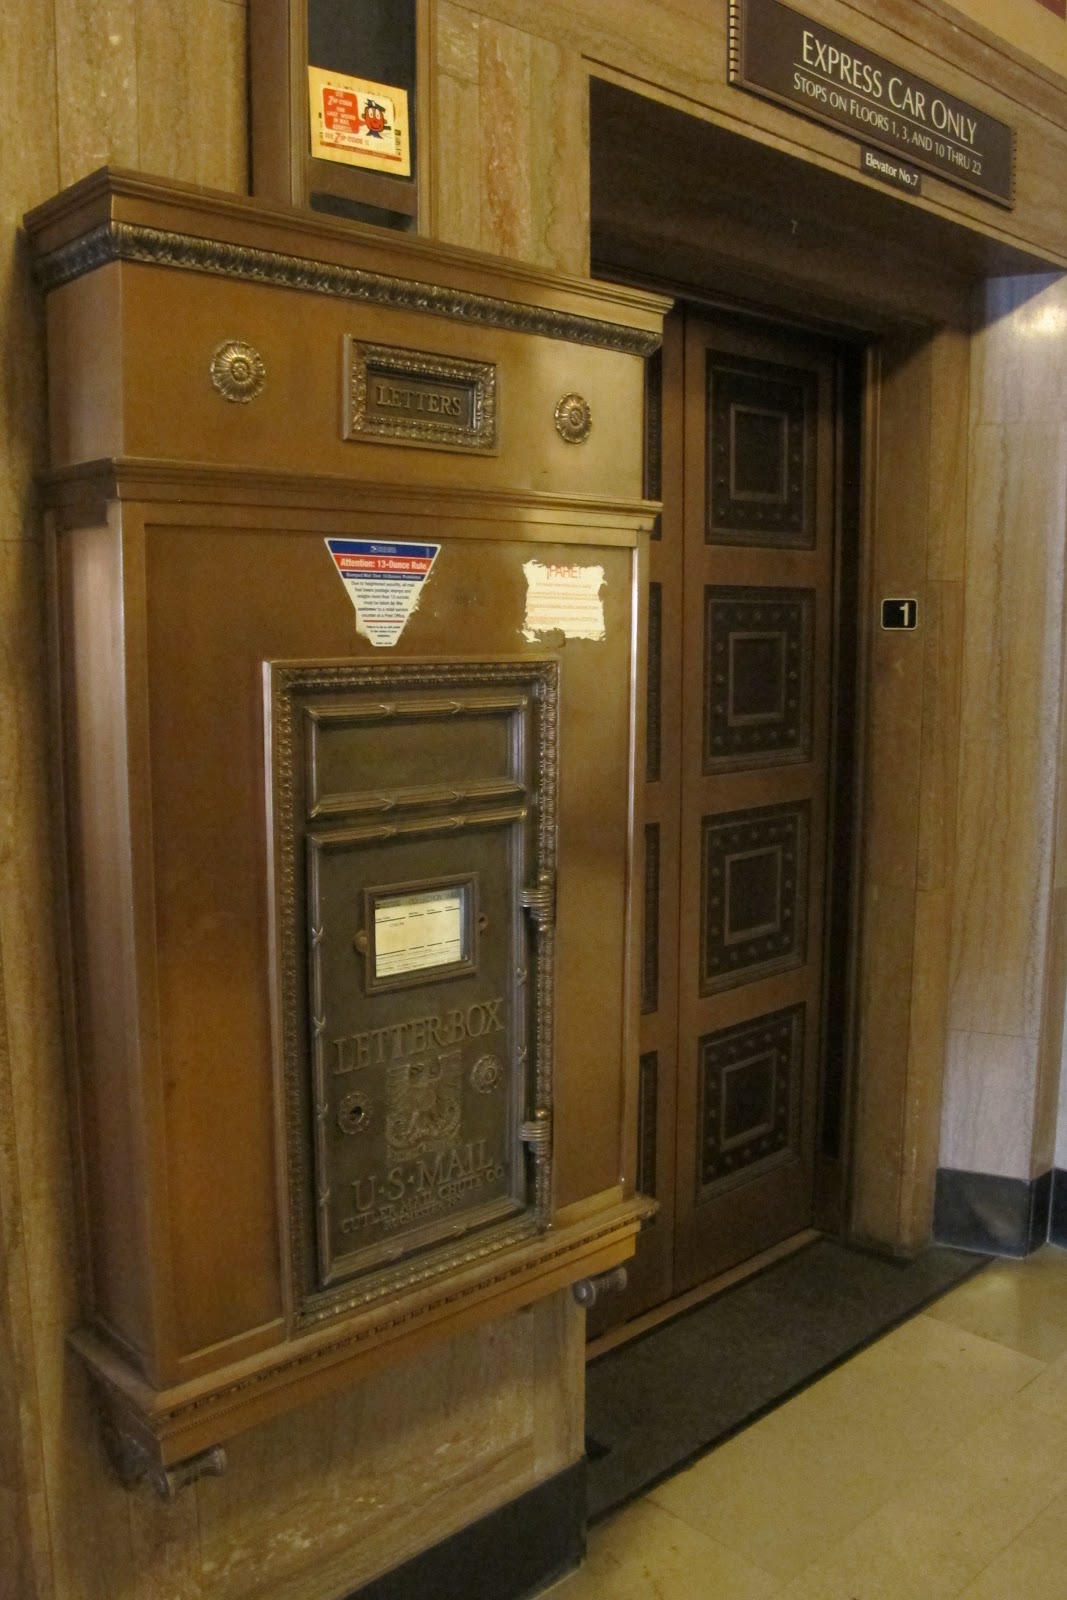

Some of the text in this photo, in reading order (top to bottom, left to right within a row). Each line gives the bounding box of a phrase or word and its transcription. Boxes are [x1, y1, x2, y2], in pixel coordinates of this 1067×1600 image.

[802, 30, 977, 145] EXPRESS CAR ONLY
[793, 72, 828, 103] STOPS
[829, 90, 847, 112] ON
[850, 99, 889, 131] FLOORS
[911, 127, 933, 152] AND
[935, 140, 946, 159] 10
[946, 145, 970, 170] THRU
[971, 157, 982, 176] 22
[865, 152, 897, 177] Elevator
[377, 385, 462, 416] LETTERS
[340, 558, 427, 570] Attention: 13-Ounce Rule
[900, 602, 909, 626] 1
